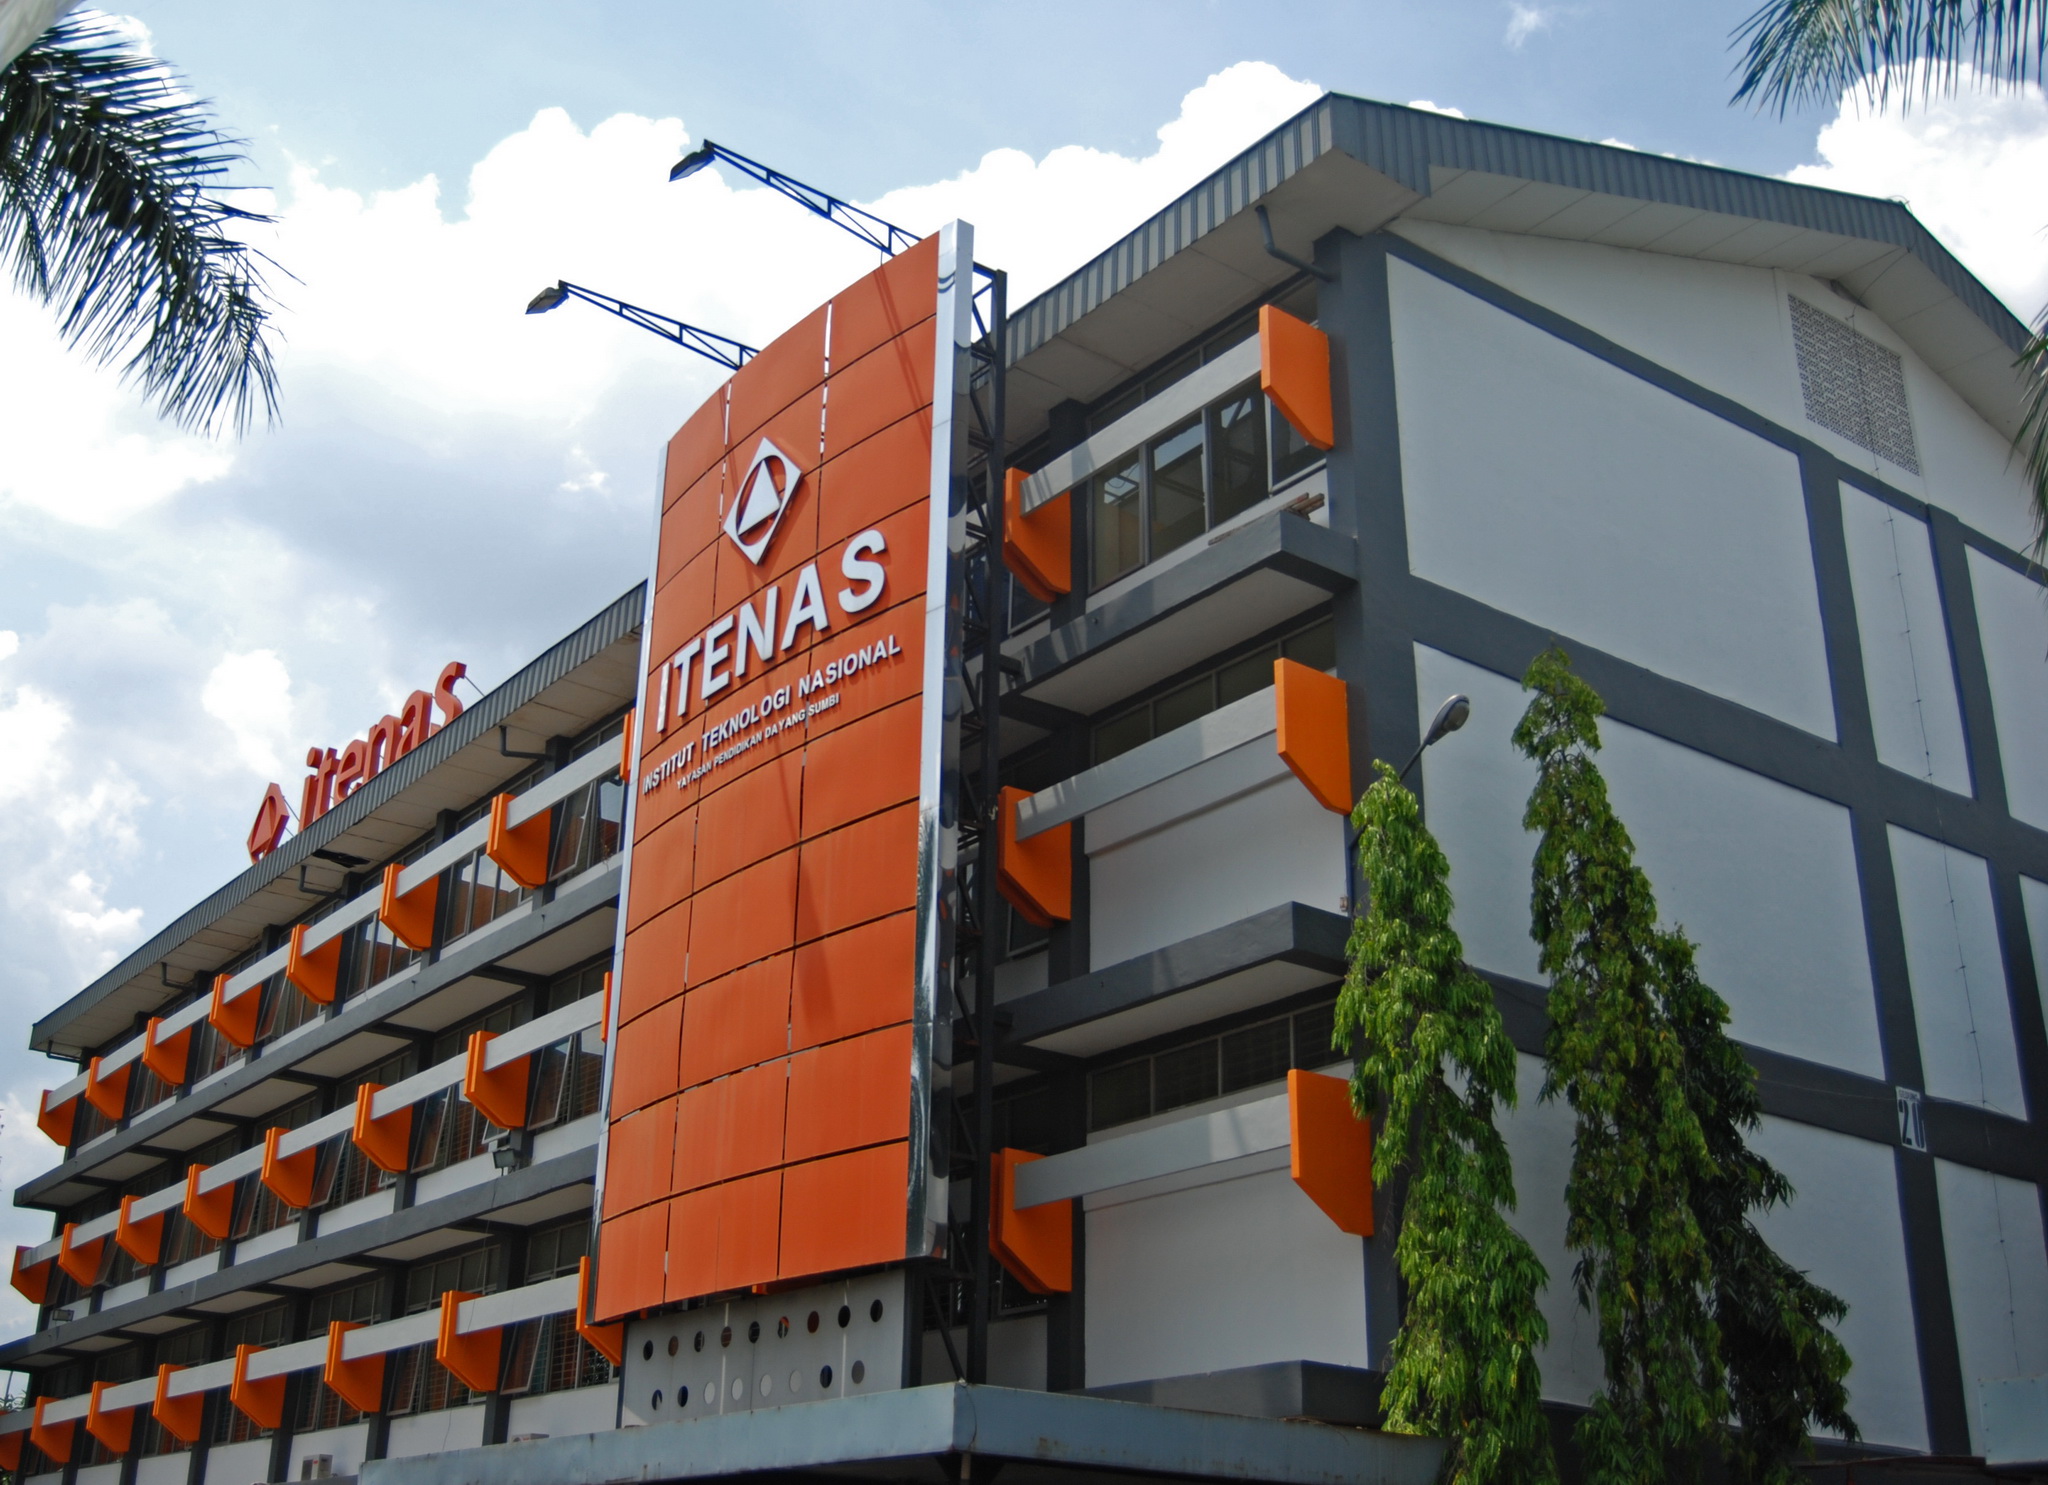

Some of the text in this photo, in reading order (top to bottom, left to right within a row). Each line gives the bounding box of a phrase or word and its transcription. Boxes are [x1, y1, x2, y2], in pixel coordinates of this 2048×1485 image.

[656, 528, 888, 734] ITENAS
[298, 661, 467, 833] itenas
[643, 634, 901, 795] INSTITUT TEKNOLOGI NASIONAL
[677, 692, 840, 790] YAYASAN PENDIDIKAN DAYANG SUMBI
[1898, 1099, 1924, 1148] 20
